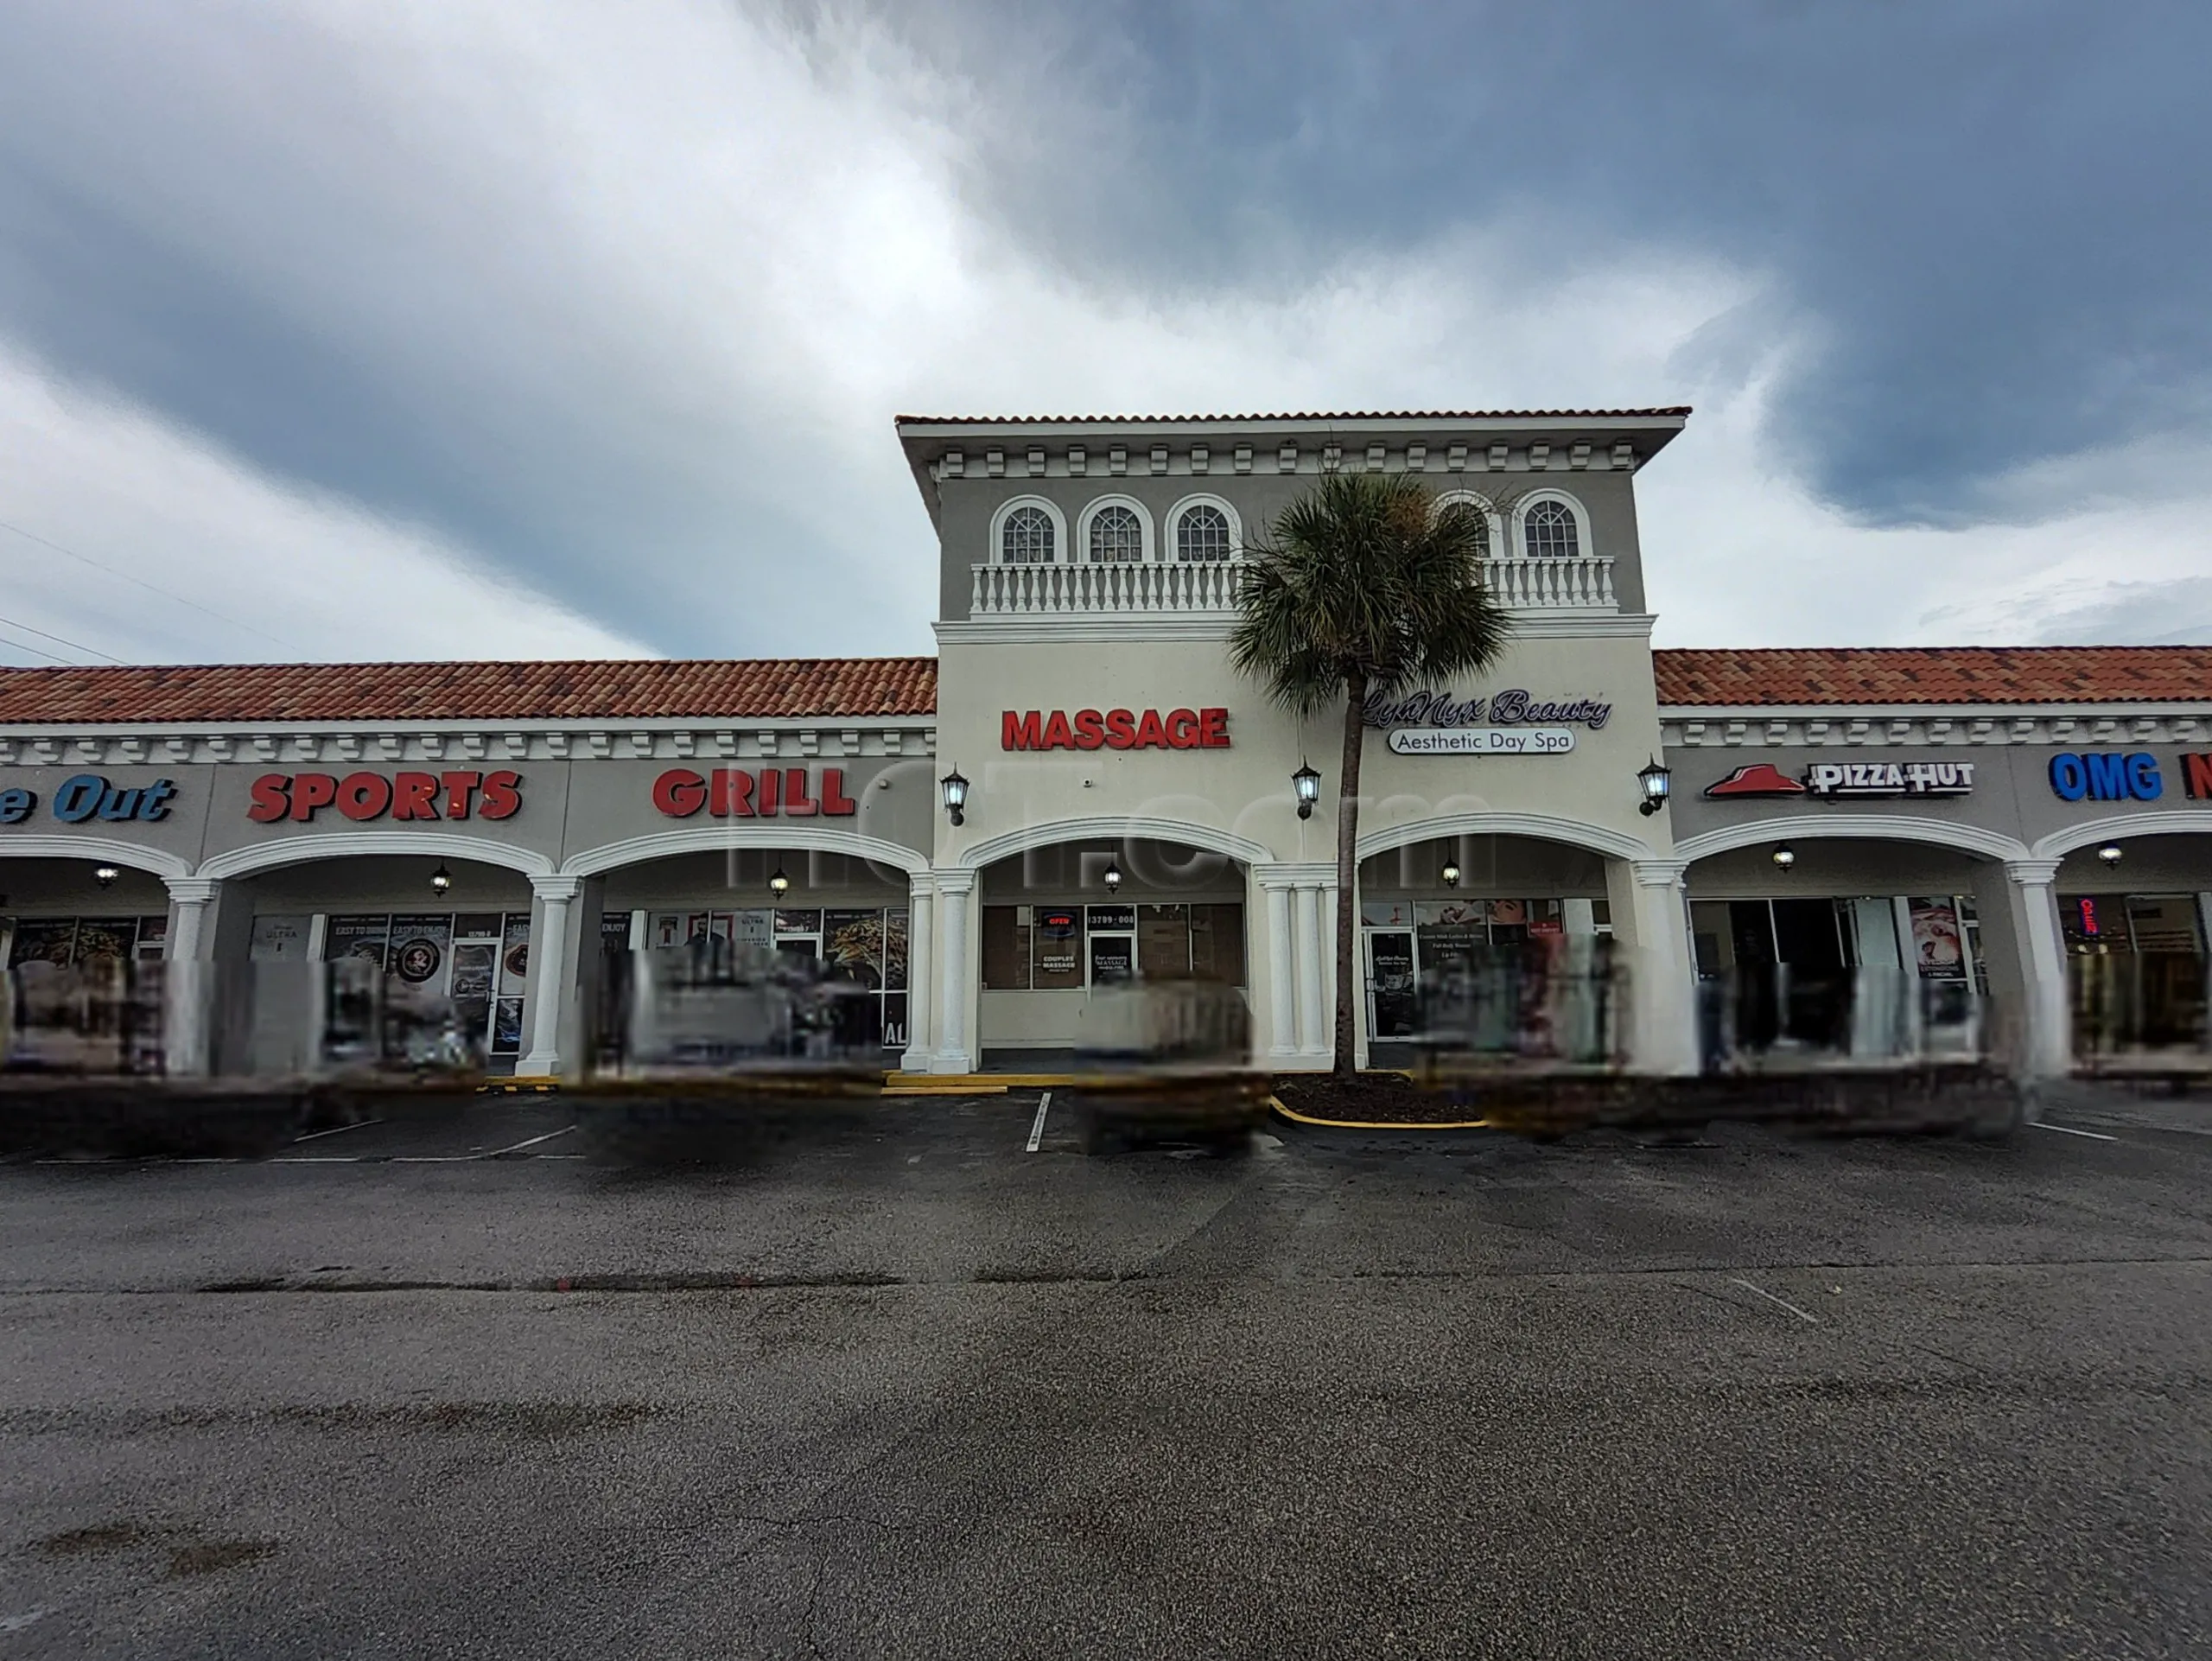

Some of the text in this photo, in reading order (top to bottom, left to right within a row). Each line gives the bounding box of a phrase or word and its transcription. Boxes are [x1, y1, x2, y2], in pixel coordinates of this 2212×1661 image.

[1001, 708, 1230, 751] MASSAGE
[1490, 690, 1612, 729] Beauty
[1397, 733, 1569, 752] Aesthetic Day Spa
[52, 773, 178, 823] Out
[246, 770, 524, 821] SPORTS
[652, 767, 855, 817] GRILL
[1809, 763, 1974, 793] PIZZA HUT
[2049, 752, 2163, 801] OMG
